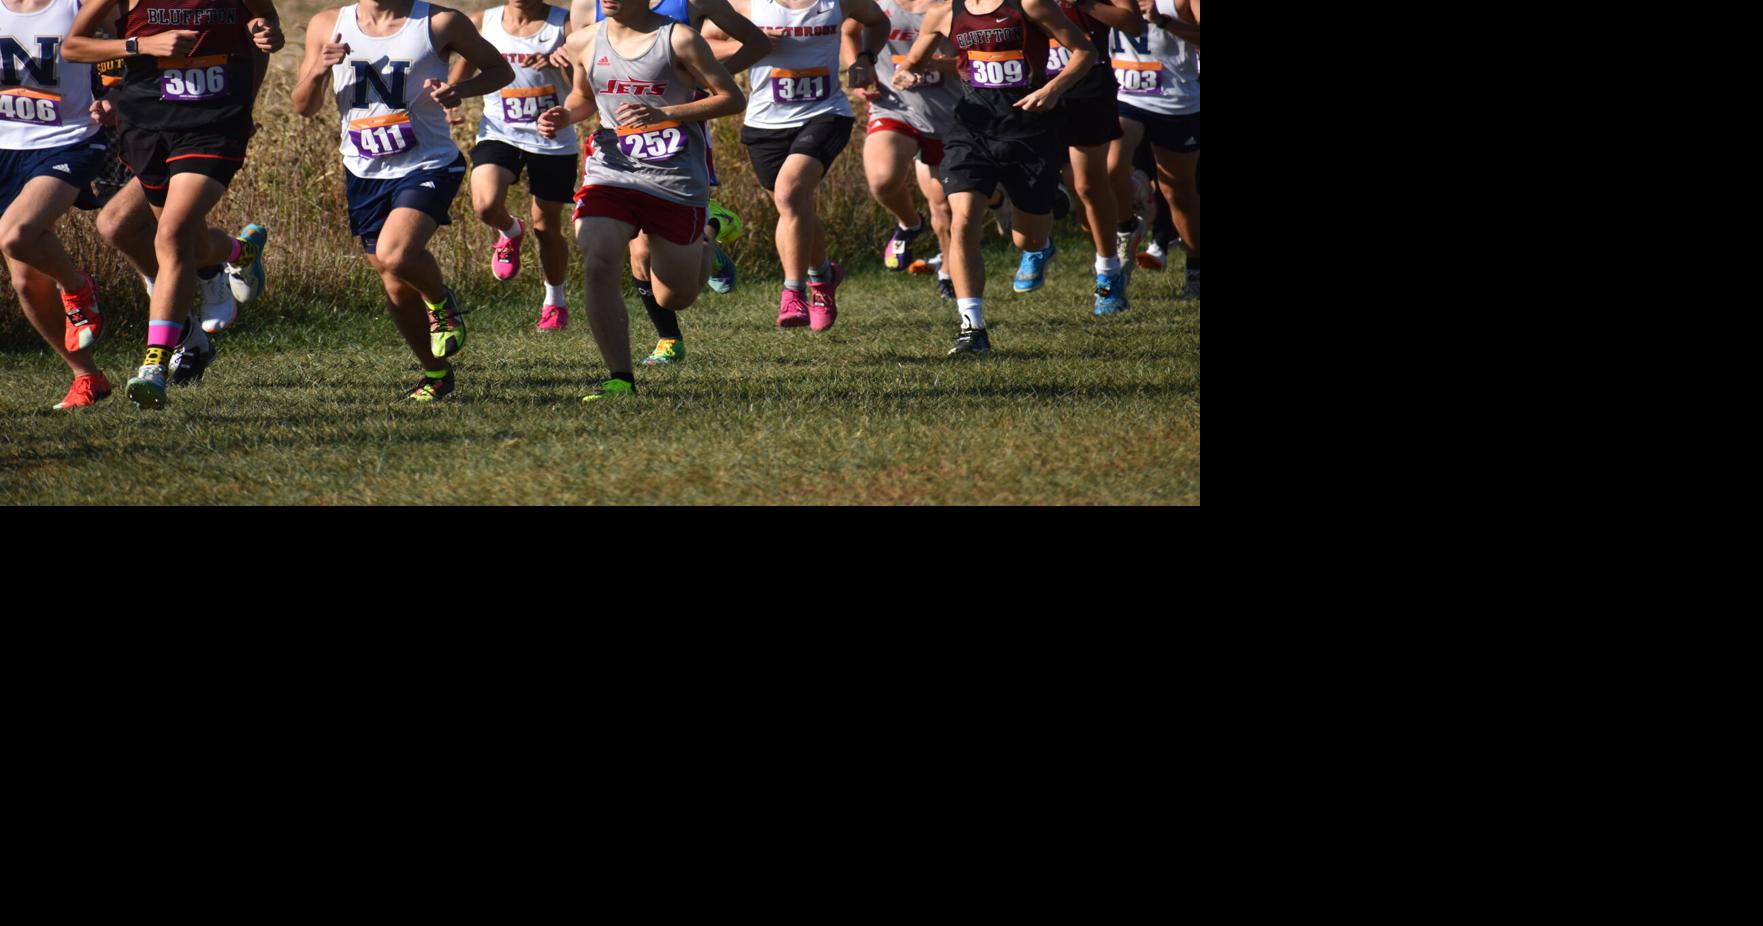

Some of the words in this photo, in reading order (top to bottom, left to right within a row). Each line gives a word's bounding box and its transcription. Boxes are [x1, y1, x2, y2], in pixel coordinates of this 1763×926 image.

[147, 8, 237, 26] BLUFFTON
[759, 25, 837, 37] TBROOK
[0, 35, 61, 87] N
[1046, 47, 1072, 70] 30
[165, 66, 225, 96] 306
[350, 57, 412, 110] N
[973, 60, 1024, 84] 309
[599, 76, 667, 96] JETS
[778, 77, 824, 99] 341
[0, 94, 56, 122] 406
[360, 124, 407, 153] 411
[625, 128, 682, 159] 252
